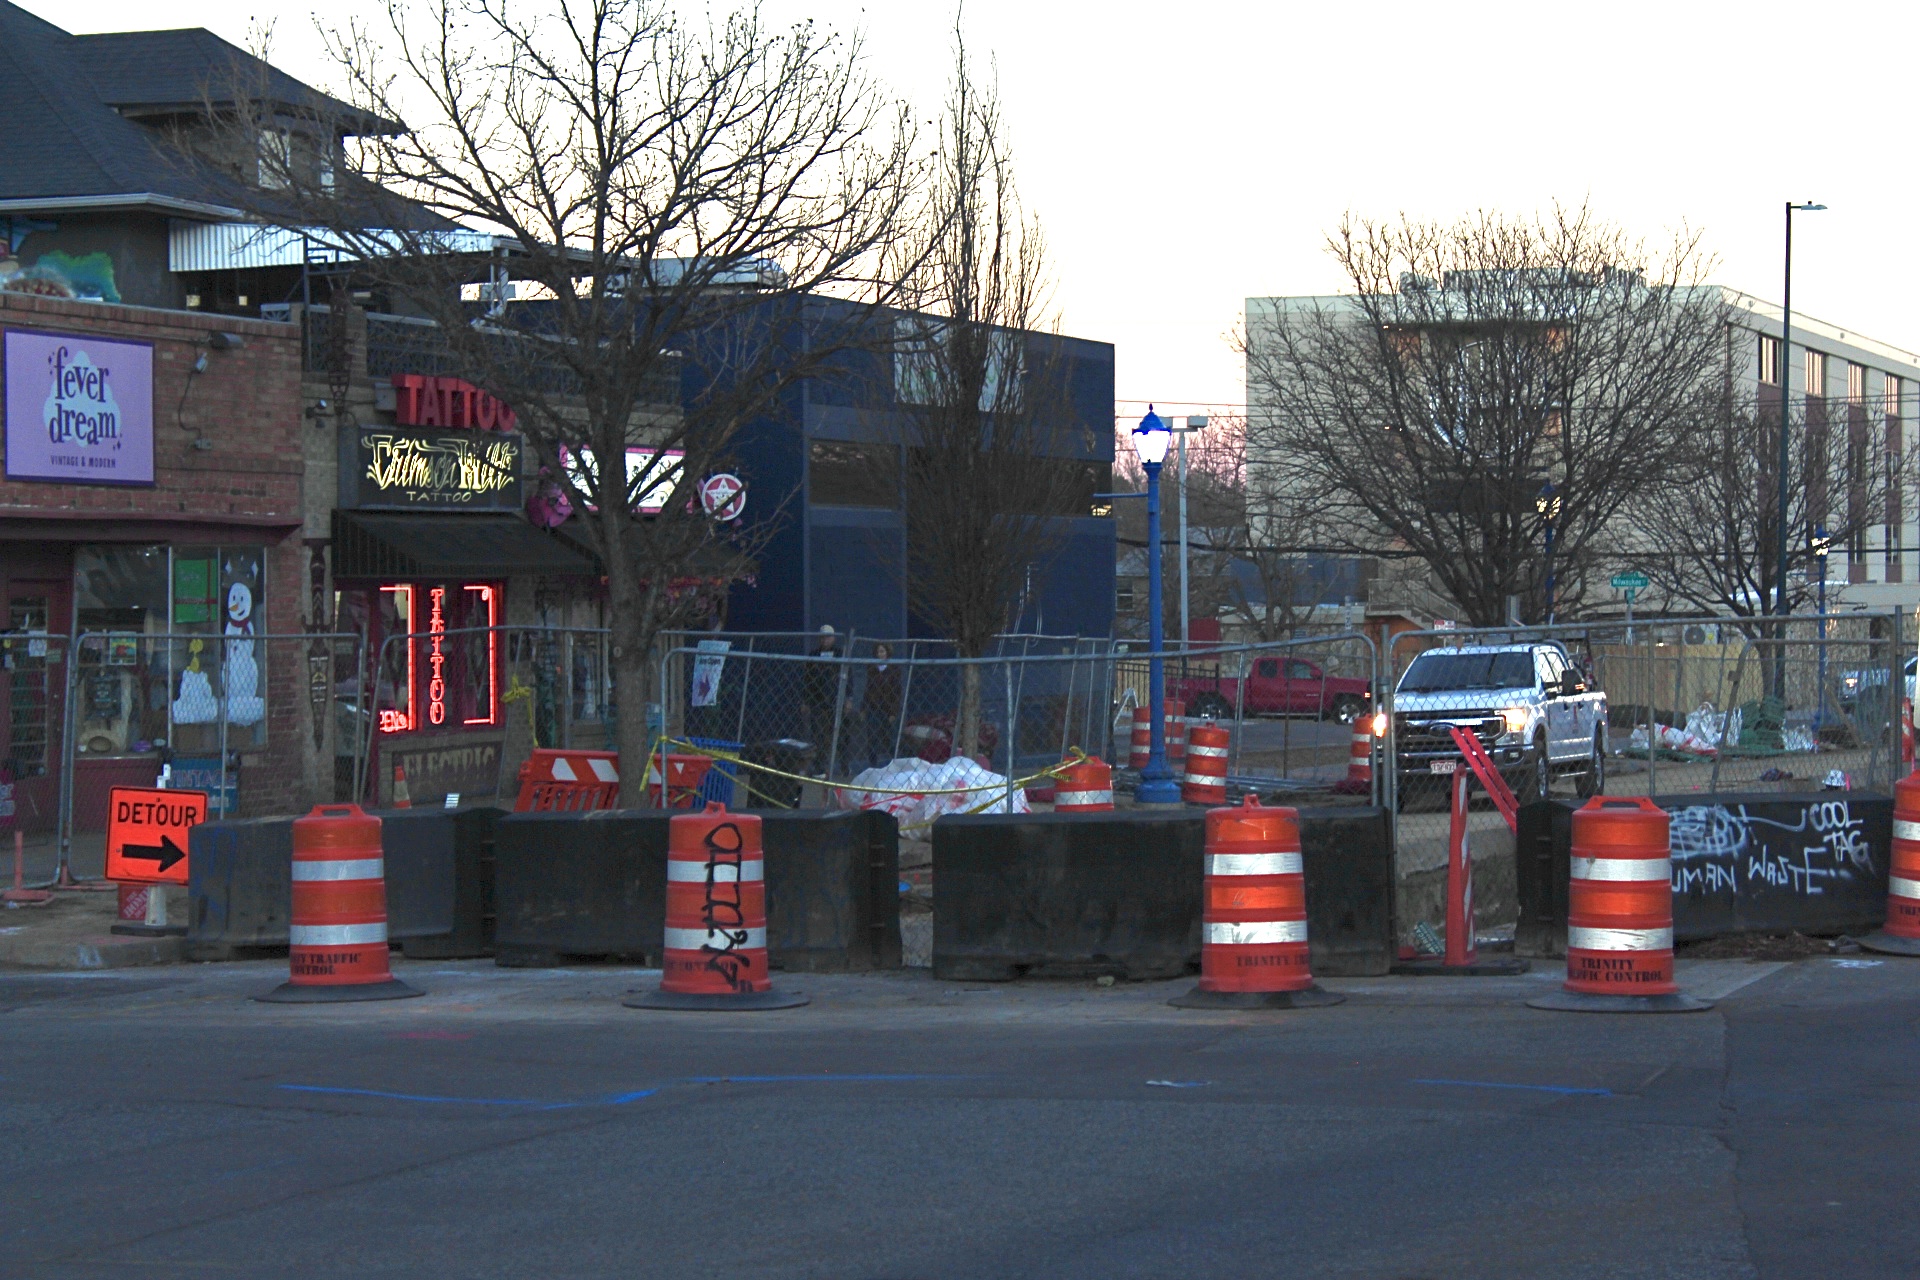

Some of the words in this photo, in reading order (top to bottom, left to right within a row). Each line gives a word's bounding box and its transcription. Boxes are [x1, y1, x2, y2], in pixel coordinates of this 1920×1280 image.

[54, 346, 109, 402] fever
[50, 403, 117, 445] dream
[51, 455, 79, 467] VINTAGE
[81, 455, 86, 467] &
[89, 457, 116, 468] MODERN
[406, 491, 472, 502] TATTOO
[117, 802, 197, 827] DETOUR
[1809, 801, 1863, 831] COOL
[1671, 862, 1737, 894] UMAN
[1582, 958, 1634, 969] TRINITY
[1605, 971, 1662, 982] CONTROL
